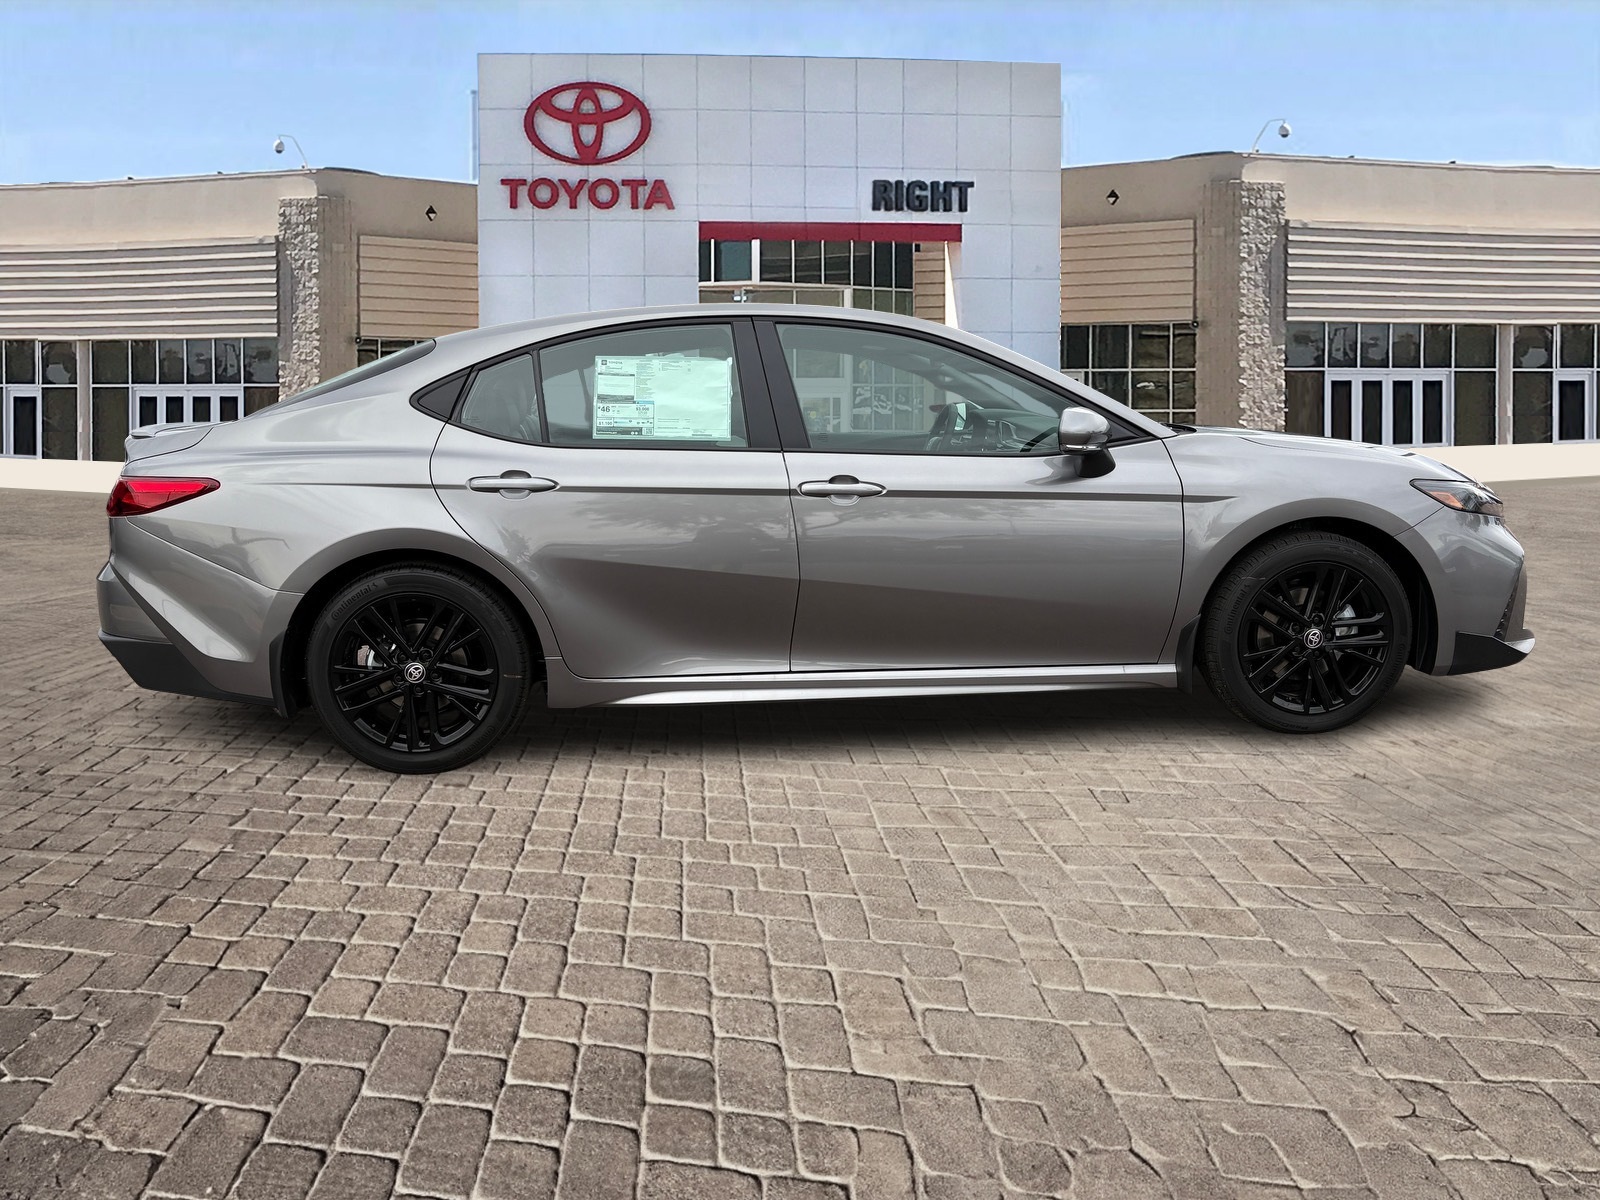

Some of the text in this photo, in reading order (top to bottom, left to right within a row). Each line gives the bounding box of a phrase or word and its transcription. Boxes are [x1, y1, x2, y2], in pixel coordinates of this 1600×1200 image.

[500, 178, 675, 210] TOYOTA
[872, 179, 975, 212] RIGHT
[331, 584, 373, 621] Continental
[1224, 588, 1248, 635] Continental
